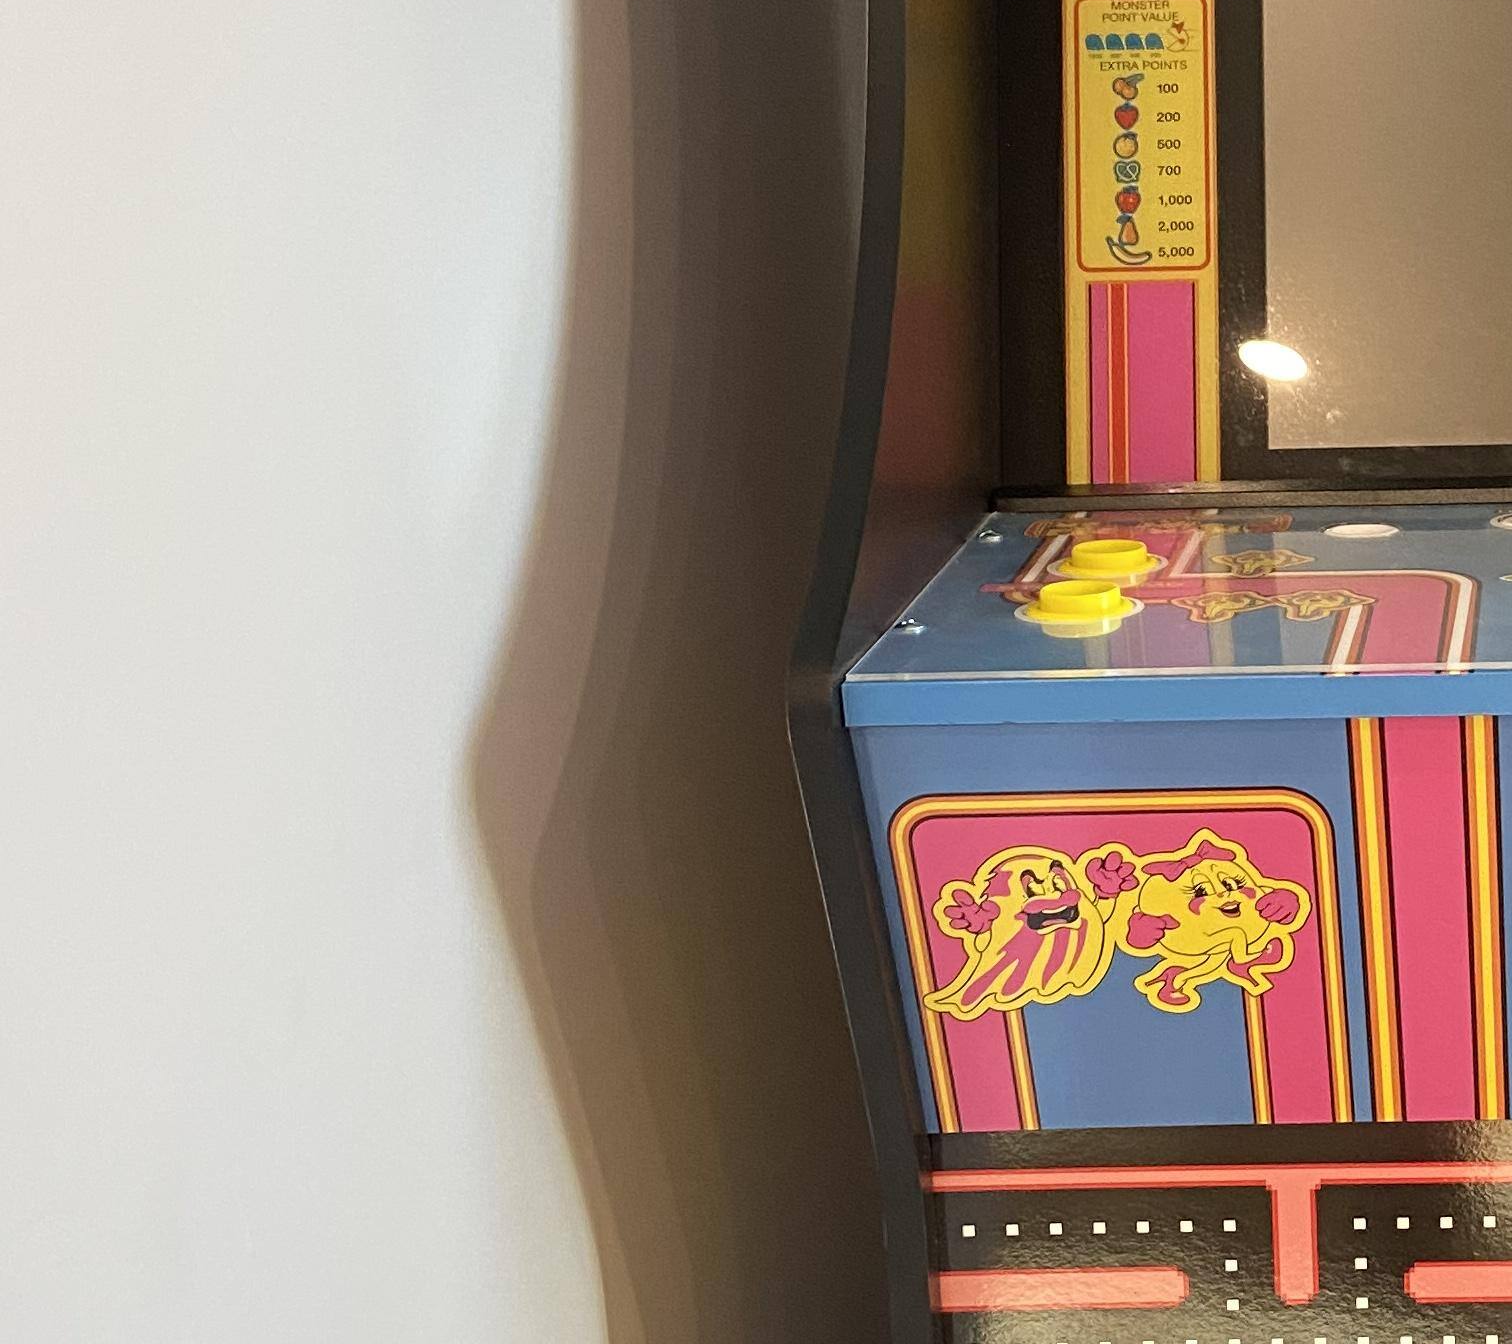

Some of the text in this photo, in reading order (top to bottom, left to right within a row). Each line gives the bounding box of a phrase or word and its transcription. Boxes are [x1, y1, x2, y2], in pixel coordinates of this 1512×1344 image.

[1111, 0, 1170, 10] MONSTER
[1102, 11, 1179, 23] POINT VALUE
[1100, 60, 1188, 71] EXTRA POINTS
[1157, 83, 1179, 94] 100
[1156, 112, 1181, 122] 200
[1157, 139, 1181, 150] 500
[1157, 165, 1181, 176] 700
[1158, 194, 1193, 206] 1,000
[1158, 221, 1194, 233] 2,000
[1158, 246, 1195, 258] 5,000
